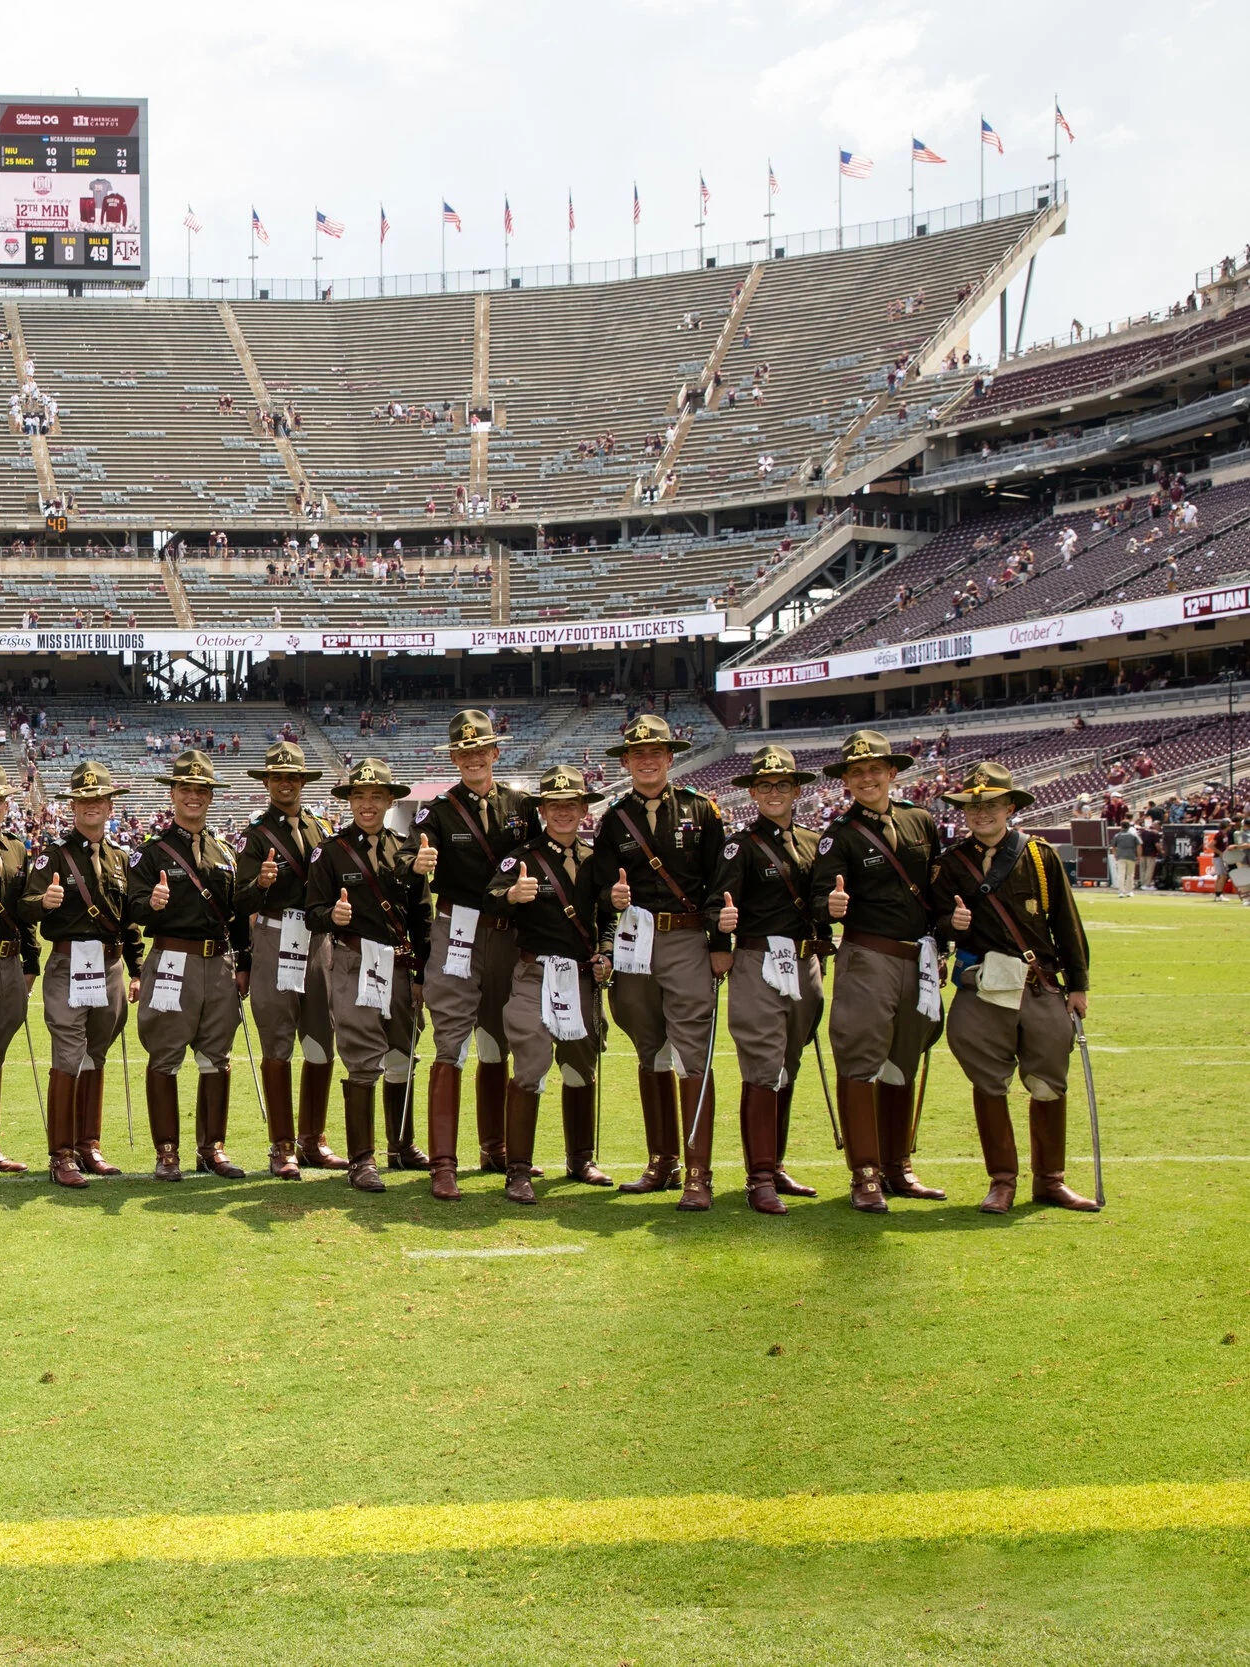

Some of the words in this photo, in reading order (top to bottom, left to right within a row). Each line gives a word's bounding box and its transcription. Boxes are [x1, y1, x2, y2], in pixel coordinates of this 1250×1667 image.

[42, 116, 59, 125] OG
[16, 204, 37, 217] 12TH
[42, 205, 68, 217] MAN
[35, 245, 44, 260] 2
[65, 246, 74, 260] 8
[90, 246, 108, 261] 49
[47, 518, 66, 532] 40
[1185, 596, 1210, 616] 12TH
[1212, 589, 1246, 612] MAN
[472, 620, 684, 645] 12THMAN.COM/FOOTBALLTICKETS
[1010, 622, 1056, 644] October
[1057, 620, 1064, 636] 2
[37, 634, 61, 648] MISS
[64, 634, 93, 648] STATE
[95, 634, 144, 648] BULLDOGS
[196, 634, 254, 647] October
[254, 634, 263, 646] 2
[323, 635, 348, 647] 12TH
[350, 635, 381, 647] MAN
[383, 633, 434, 646] MOBILE
[902, 645, 916, 665] MISS
[918, 642, 937, 662] STATE
[939, 636, 971, 659] BULLDOGS
[739, 670, 769, 685] TEXAS
[771, 668, 790, 683] A&M
[793, 664, 826, 680] FOOTBALL
